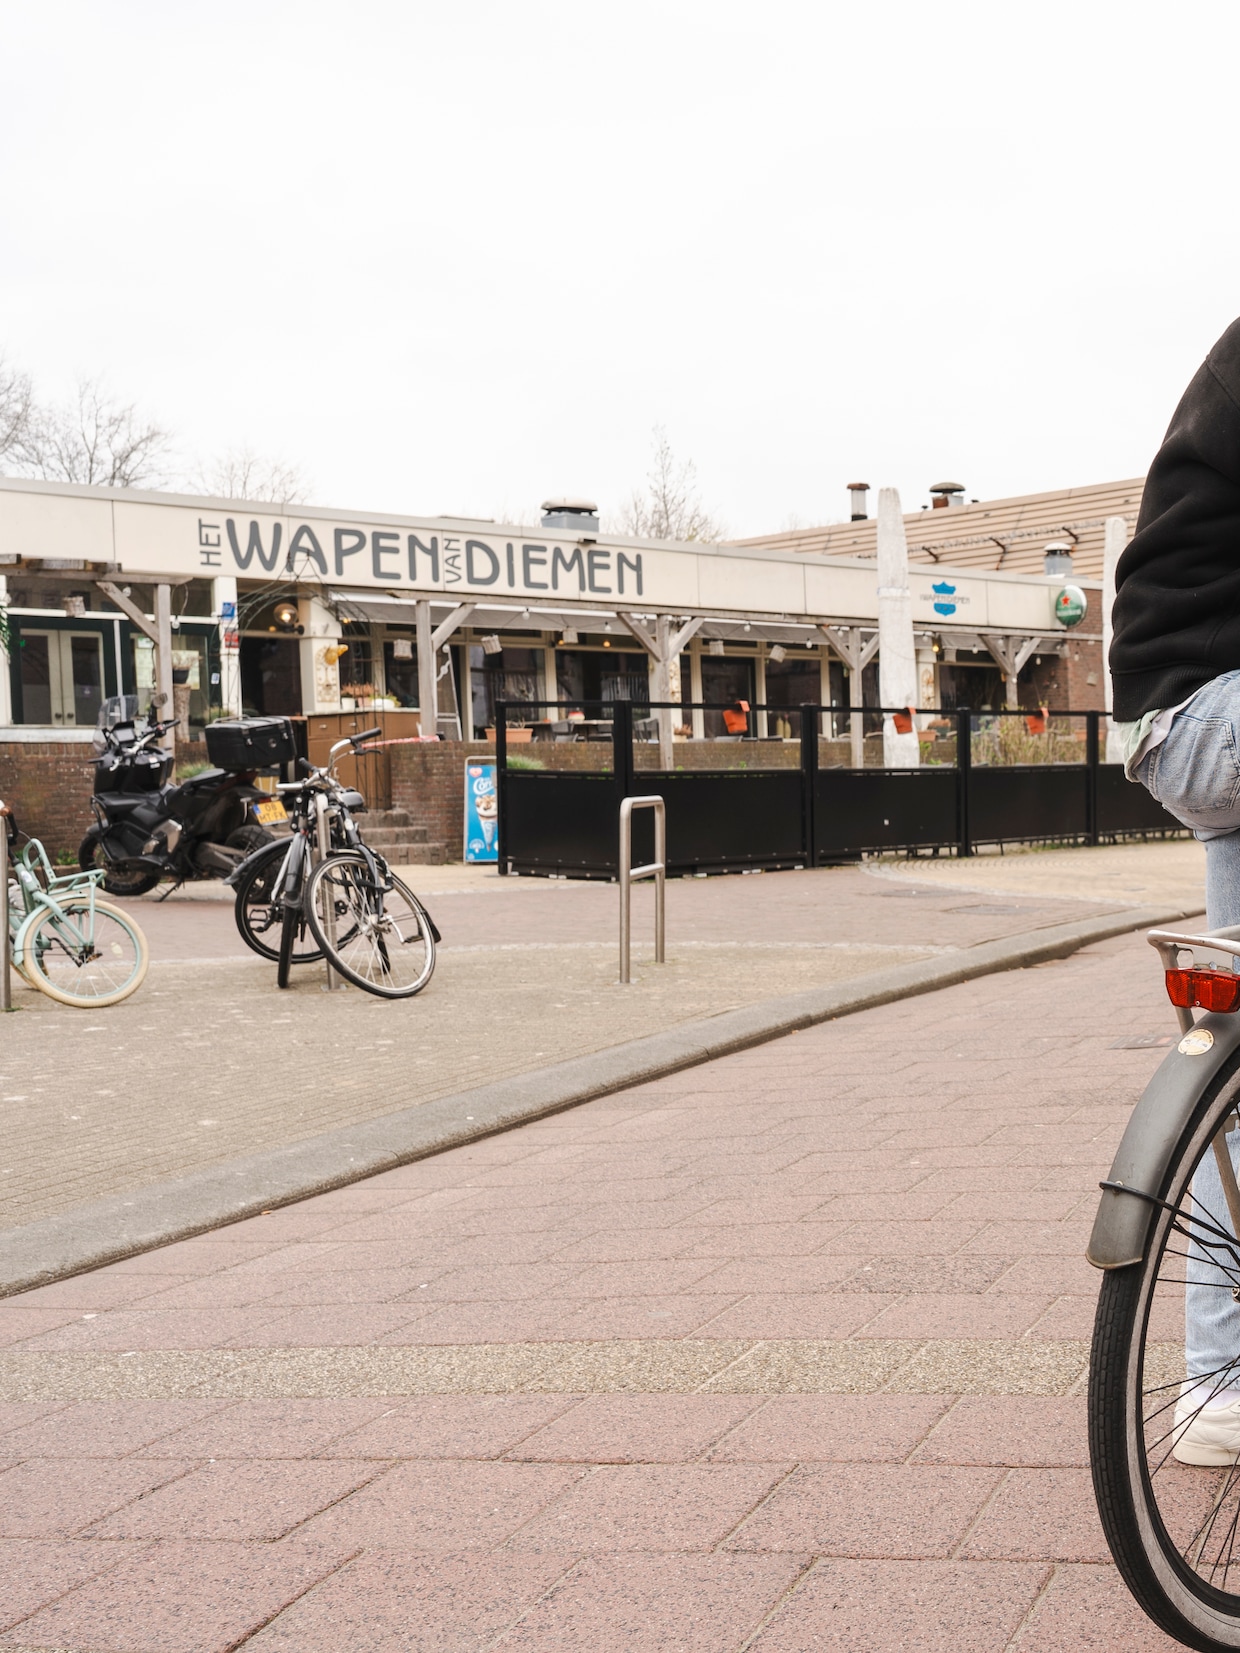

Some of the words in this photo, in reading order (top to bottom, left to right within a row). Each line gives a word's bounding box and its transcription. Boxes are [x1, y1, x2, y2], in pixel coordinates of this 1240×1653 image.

[198, 518, 222, 567] HET
[226, 518, 440, 583] WAPEN
[444, 538, 462, 584] VAN
[465, 539, 643, 596] DIEMEN
